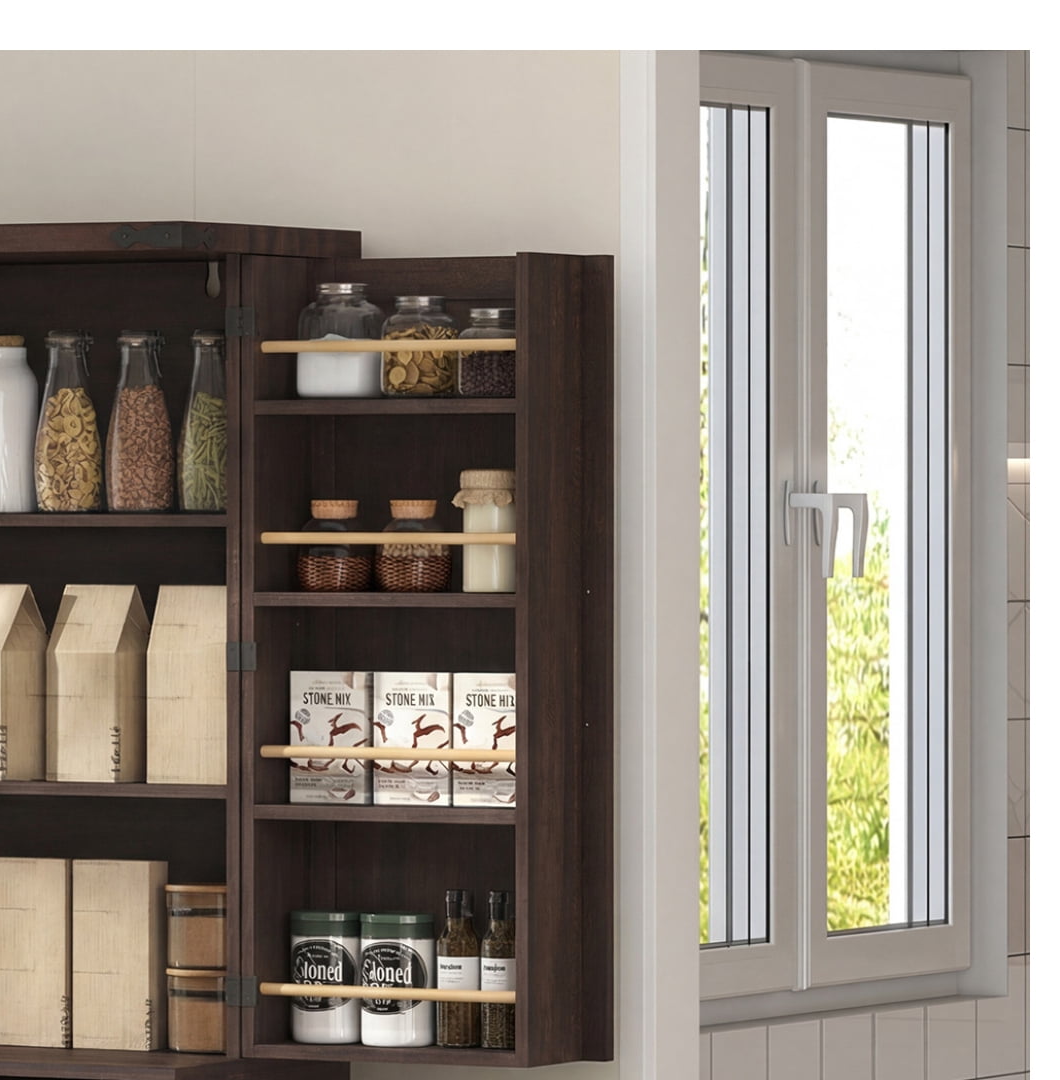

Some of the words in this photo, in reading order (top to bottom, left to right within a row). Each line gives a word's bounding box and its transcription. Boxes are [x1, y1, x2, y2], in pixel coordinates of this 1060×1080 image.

[302, 692, 334, 706] STONE
[385, 692, 416, 706] STONE
[465, 693, 497, 708] STONE
